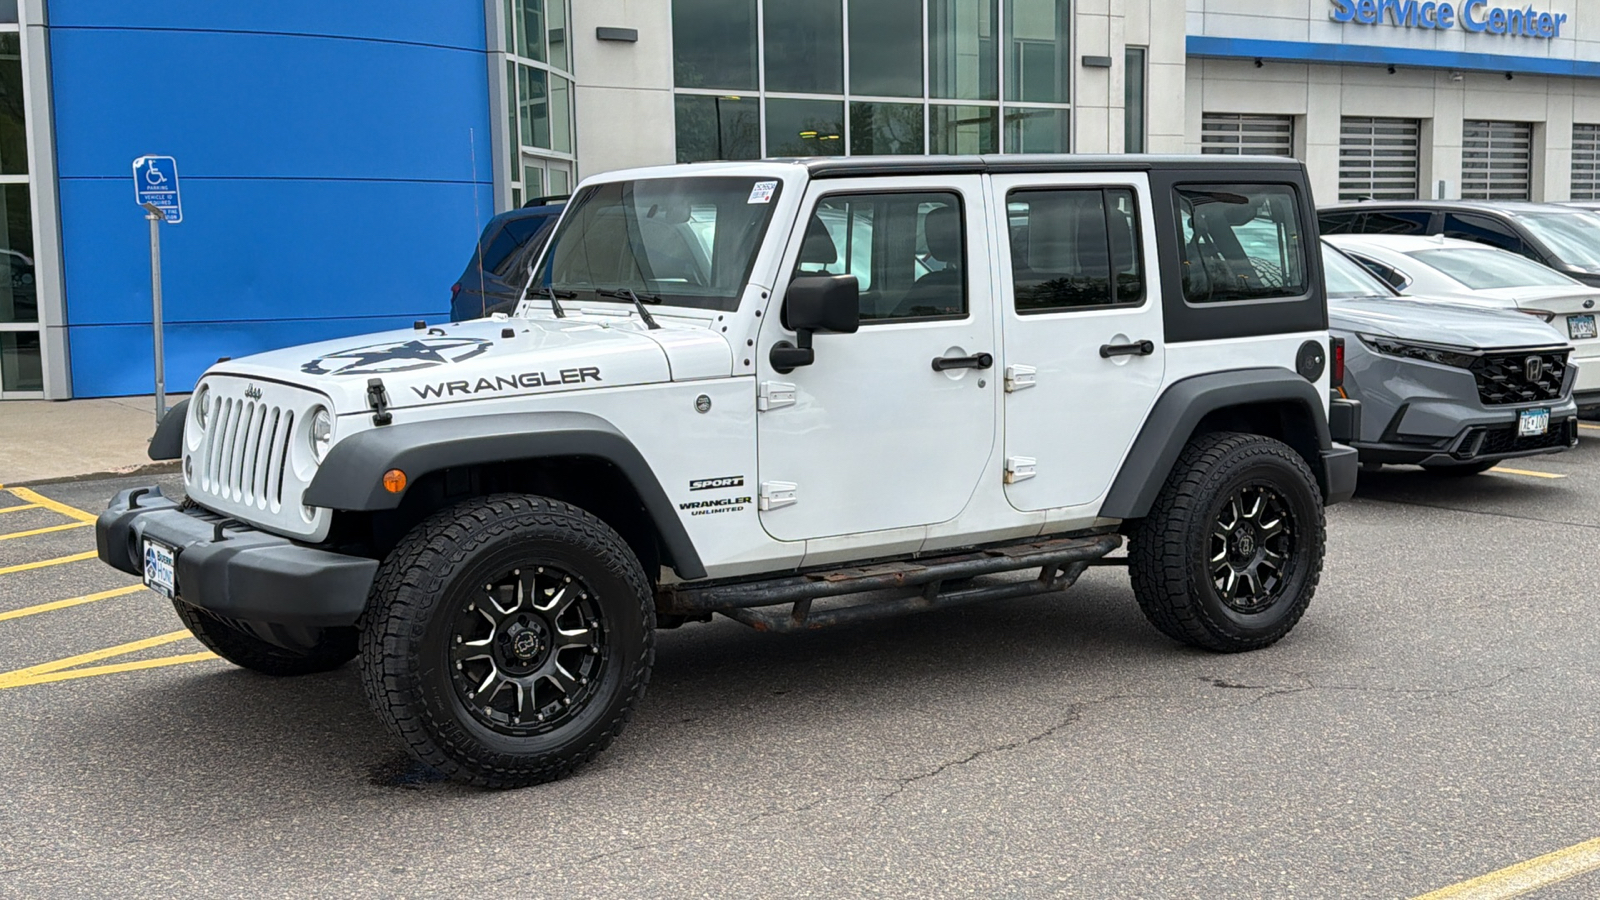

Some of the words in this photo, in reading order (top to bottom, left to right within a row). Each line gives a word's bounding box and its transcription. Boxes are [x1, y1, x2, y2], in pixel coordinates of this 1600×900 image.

[1331, 0, 1454, 29] Service
[1462, 0, 1567, 38] Center
[410, 366, 602, 399] WRANGLER
[691, 477, 742, 489] SPORT
[679, 496, 752, 510] WRANGLER
[691, 506, 744, 516] UNLIMITED
